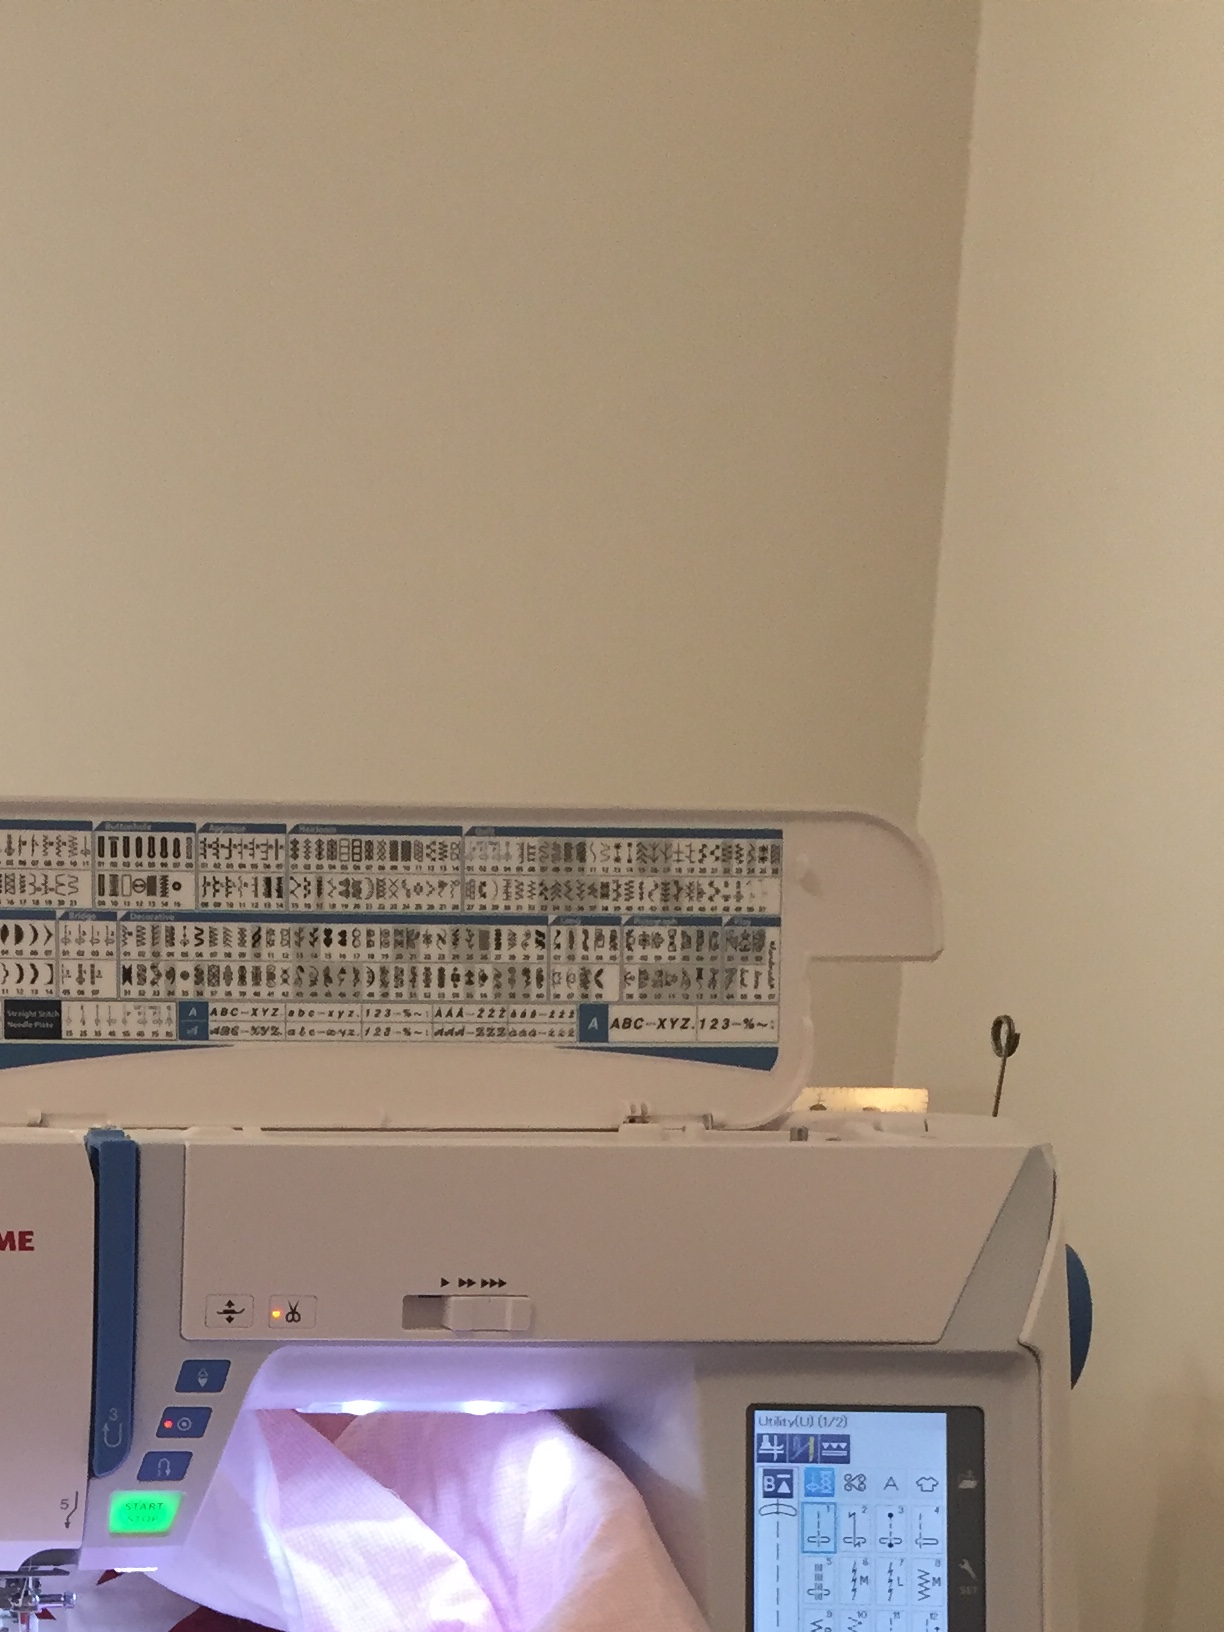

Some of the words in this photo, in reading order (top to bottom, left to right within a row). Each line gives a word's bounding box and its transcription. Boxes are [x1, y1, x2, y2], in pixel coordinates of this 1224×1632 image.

[129, 913, 175, 921] Decorative
[7, 1010, 37, 1019] Straight
[7, 1020, 32, 1029] Needle
[34, 1021, 54, 1029] Plate
[588, 1017, 599, 1030] A
[109, 1407, 119, 1421] 3
[758, 1414, 815, 1428] Utility(U)
[817, 1414, 848, 1428] (1/2)
[763, 1475, 776, 1492] B
[883, 1476, 899, 1490] A
[60, 1498, 70, 1511] 5
[125, 1502, 164, 1511] START
[862, 1505, 868, 1514] 2
[898, 1505, 905, 1514] 3
[934, 1506, 940, 1514] 4
[826, 1558, 833, 1566] 5
[899, 1558, 905, 1566] 7
[859, 1575, 869, 1586] M
[897, 1576, 904, 1587] L
[932, 1576, 942, 1587] M
[826, 1610, 833, 1618] 9
[857, 1610, 868, 1619] 10
[893, 1611, 901, 1620] 11
